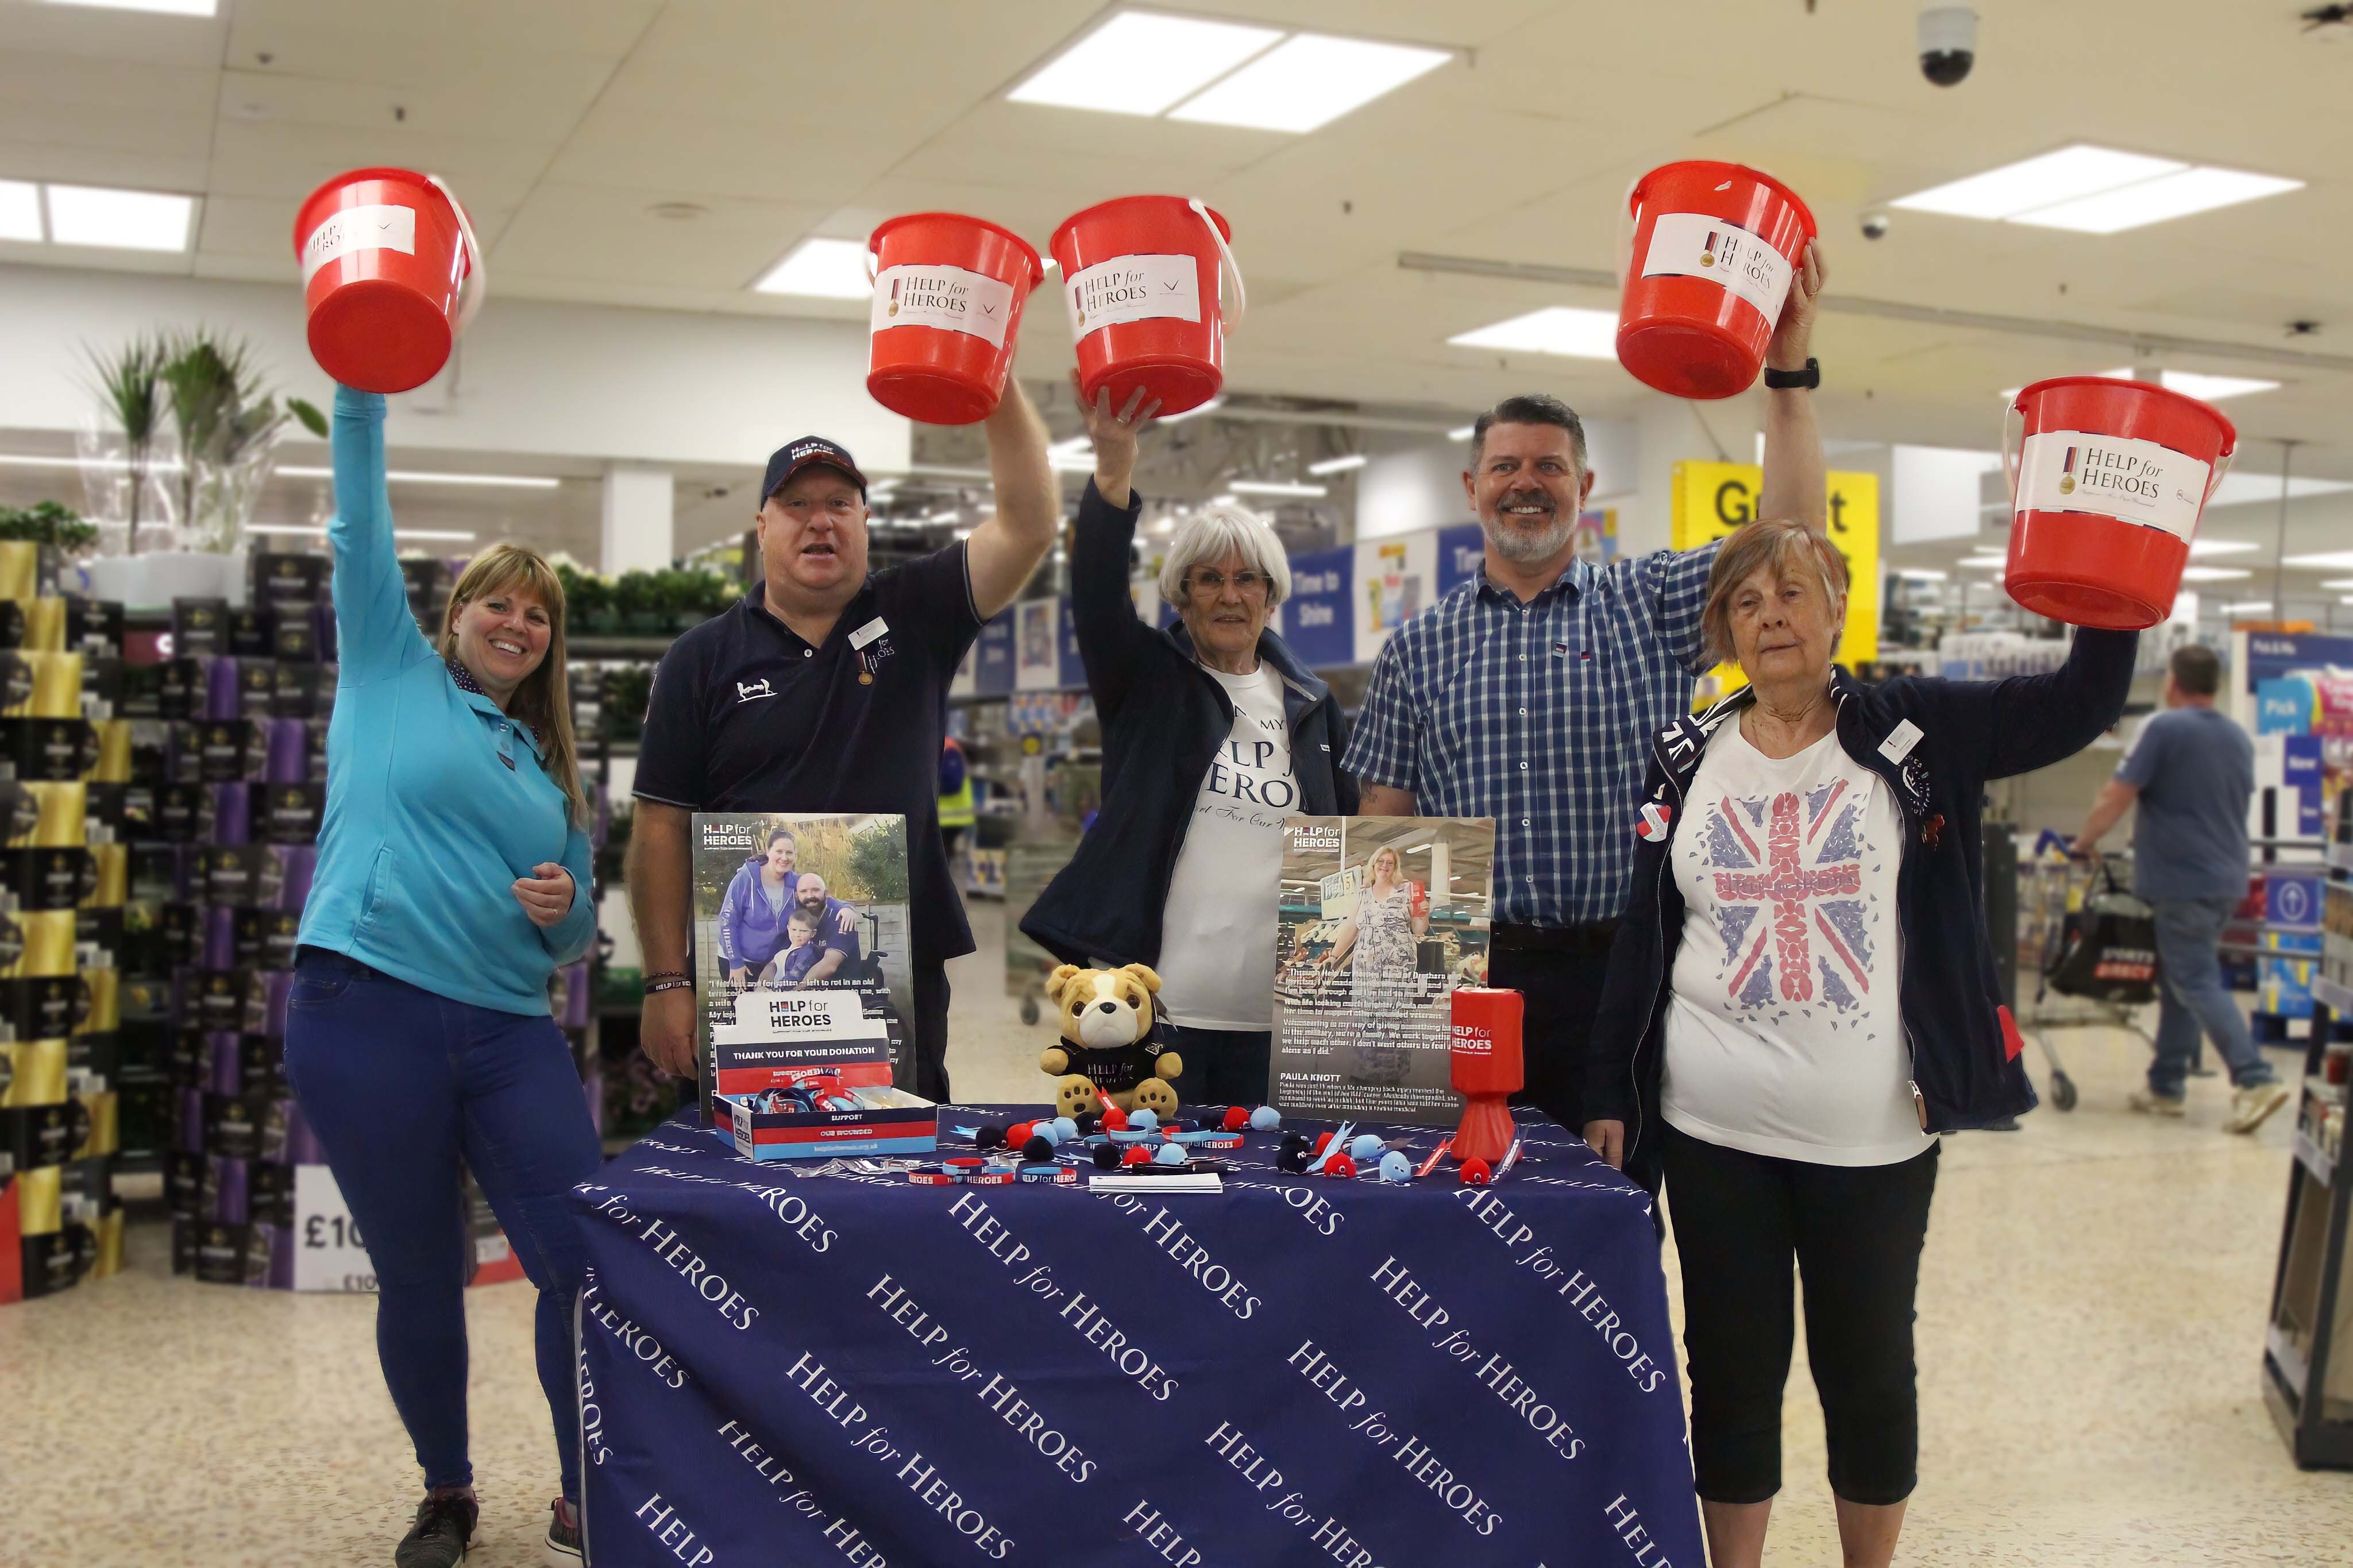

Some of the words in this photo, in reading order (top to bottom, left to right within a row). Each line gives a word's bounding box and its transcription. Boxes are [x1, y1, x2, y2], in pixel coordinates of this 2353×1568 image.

[906, 276, 946, 292] HELP
[948, 281, 969, 296] for
[1085, 272, 1121, 295] HELP
[1124, 270, 1145, 287] for
[903, 292, 967, 312] HEROES
[1087, 286, 1147, 312] HEROES
[2086, 448, 2138, 470] HELP
[2136, 460, 2163, 477] for
[2082, 468, 2159, 499] HEROES
[1260, 719, 1286, 731] MY
[704, 835, 752, 845] HEROES
[735, 824, 751, 835] for
[1294, 837, 1340, 848] HEROES
[1324, 826, 1341, 837] for
[809, 1000, 828, 1011] for
[770, 1014, 831, 1028] HEROES
[1475, 1026, 1492, 1038] for
[733, 1052, 764, 1060] THANK
[765, 1051, 784, 1059] YOU
[785, 1050, 803, 1058] FOR
[804, 1049, 828, 1057] YOUR
[829, 1046, 875, 1056] DONATION
[1280, 1072, 1309, 1081] PAULA
[1310, 1073, 1341, 1082] KNOTT
[591, 1194, 641, 1225] for
[639, 1218, 760, 1331] HEROES
[1141, 1205, 1262, 1320] HEROES
[947, 1191, 1031, 1266] HELP
[1013, 1265, 1064, 1300] for
[1058, 1291, 1179, 1402] HEROES
[1514, 1246, 1564, 1280] for
[1557, 1268, 1667, 1393] HEROES
[1370, 1254, 1450, 1331] HELP
[1432, 1329, 1481, 1363] for
[1475, 1351, 1586, 1461] HEROES
[866, 1272, 949, 1347] HELP
[931, 1347, 983, 1381] for
[977, 1370, 1098, 1484] HEROES
[1286, 1338, 1367, 1412] HELP
[1348, 1411, 1399, 1446] for
[1392, 1434, 1503, 1536] HEROES
[785, 1350, 868, 1428] HELP
[850, 1427, 902, 1462] for
[895, 1451, 1016, 1559] HEROES
[716, 1419, 794, 1486] HELP
[778, 1489, 827, 1519] for
[1204, 1419, 1283, 1492] HELP
[1266, 1492, 1316, 1526] for
[634, 1492, 714, 1568] HELP
[1121, 1498, 1202, 1568] HELP
